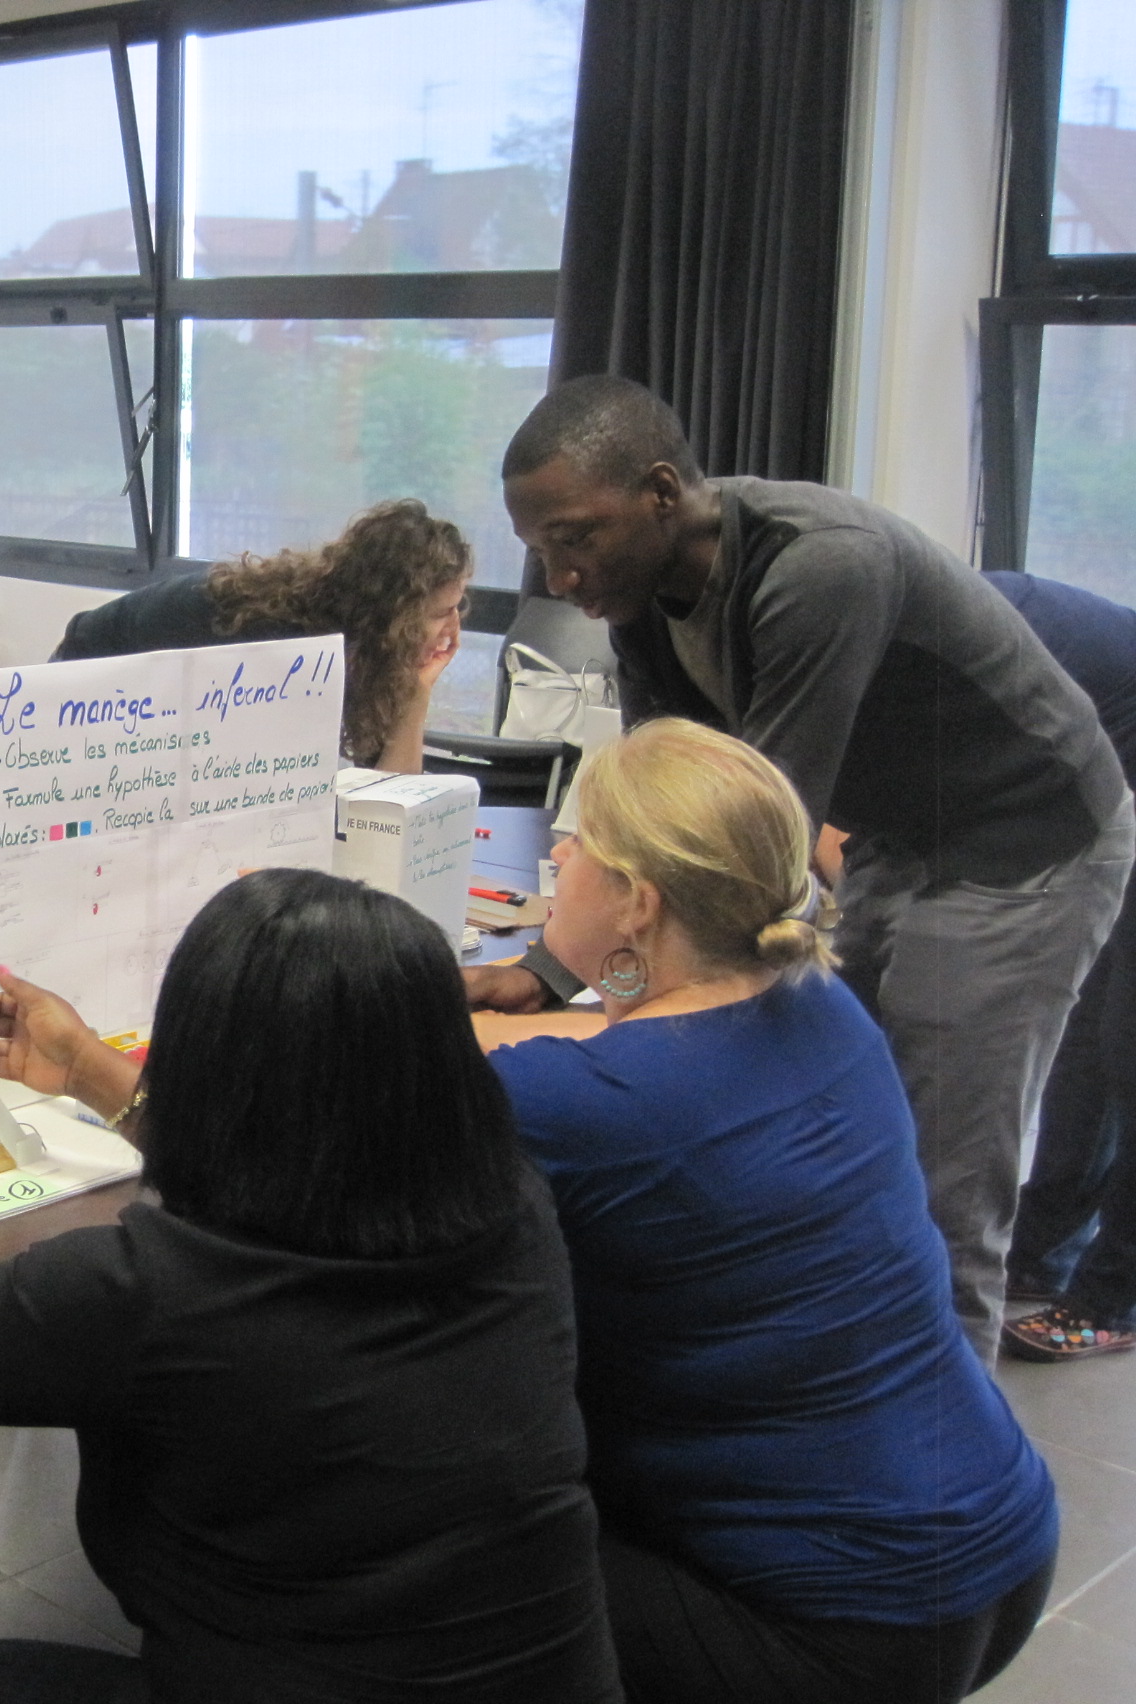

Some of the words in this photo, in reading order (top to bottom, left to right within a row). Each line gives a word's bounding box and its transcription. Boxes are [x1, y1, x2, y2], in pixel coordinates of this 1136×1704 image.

[5, 737, 72, 769] Observe
[84, 737, 107, 760] les
[2, 776, 65, 809] Formule
[70, 784, 101, 801] une
[107, 764, 177, 802] hypothèse
[245, 752, 268, 774] des
[272, 752, 320, 777] papiers
[102, 806, 155, 830] Recopie
[159, 797, 175, 821] la
[189, 799, 211, 816] sur
[214, 797, 239, 812] une
[279, 782, 294, 801] de
[356, 819, 368, 830] EN
[369, 820, 401, 836] FRANCE
